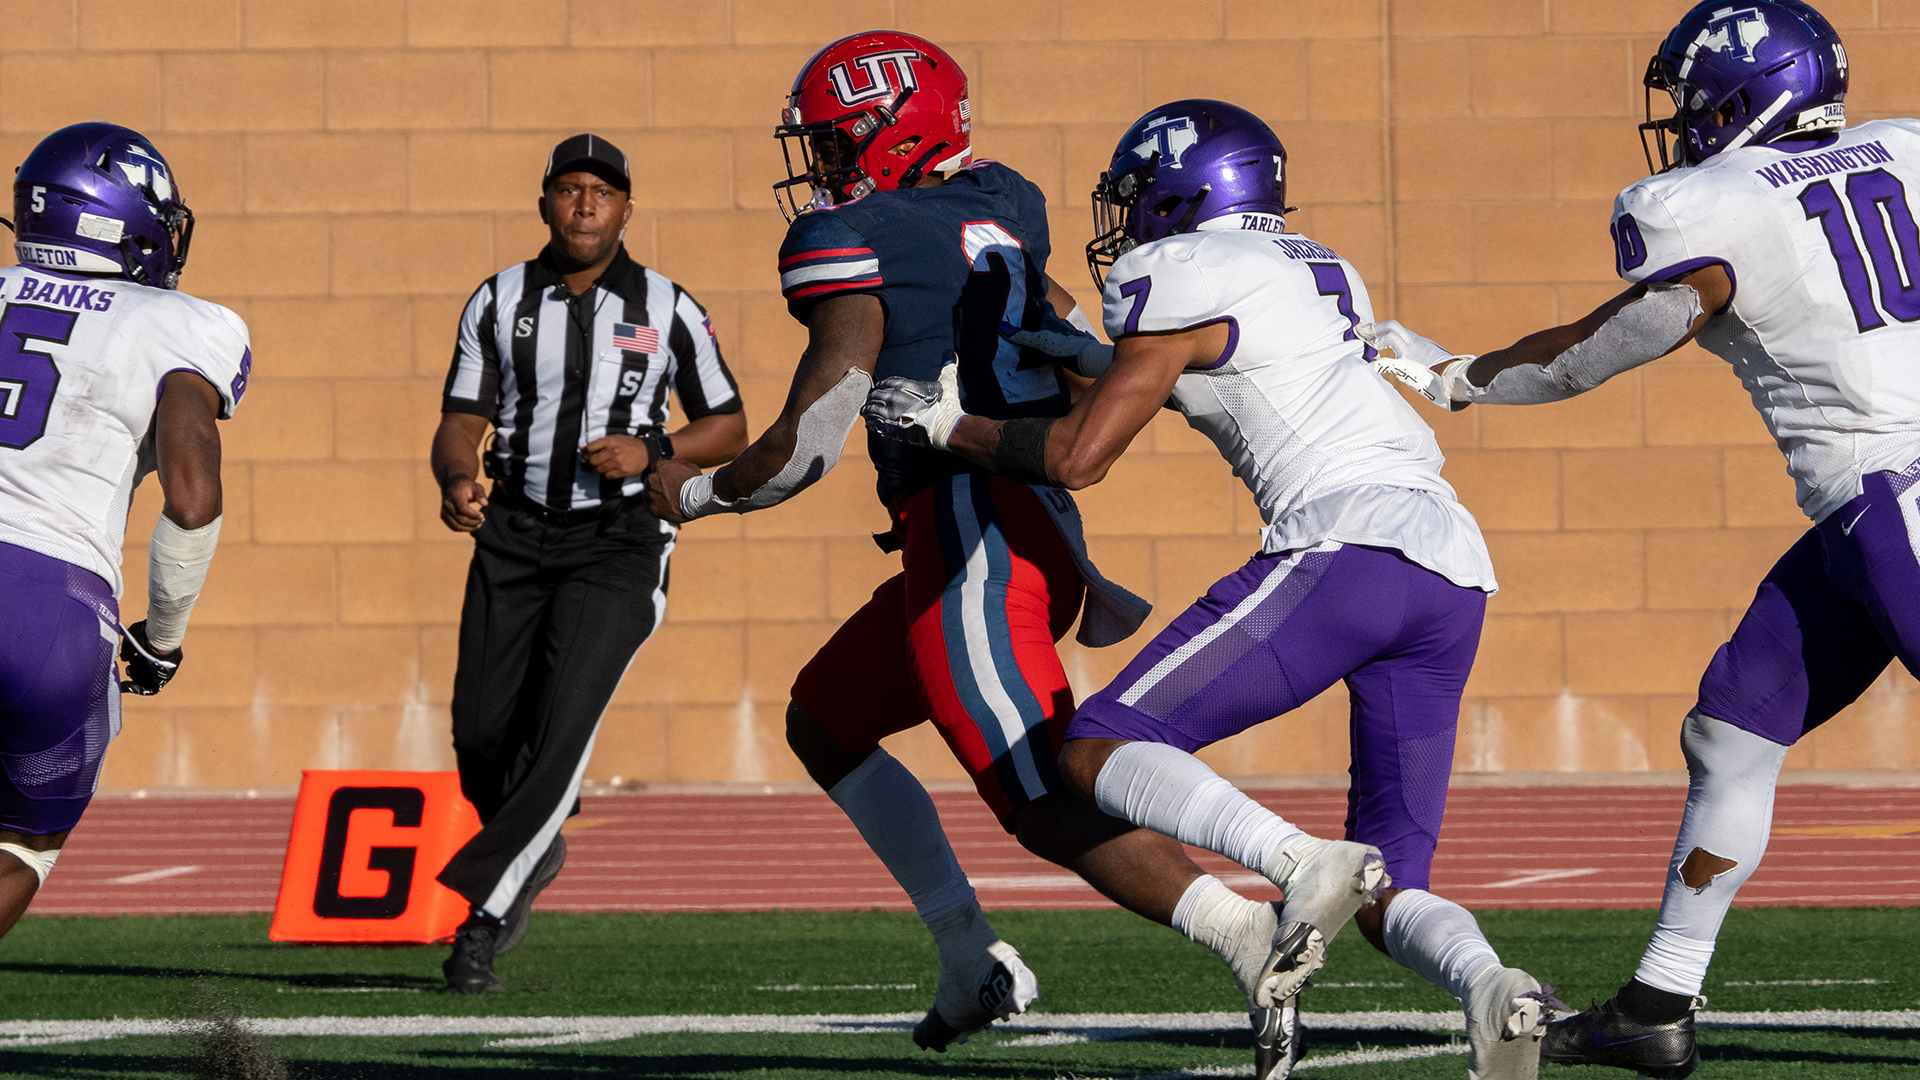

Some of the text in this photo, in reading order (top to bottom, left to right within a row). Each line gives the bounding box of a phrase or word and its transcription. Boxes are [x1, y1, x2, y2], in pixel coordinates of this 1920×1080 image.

[1832, 43, 1848, 69] 10
[1273, 155, 1282, 182] 7
[1755, 140, 1895, 189] WASHINGTON
[31, 185, 46, 213] 5
[15, 244, 77, 267] ARLETON
[1796, 167, 1920, 334] 10
[15, 276, 116, 312] BANKS
[961, 220, 1061, 404] 2
[1119, 275, 1152, 333] 7
[1305, 261, 1379, 363] 7
[515, 317, 534, 337] S
[0, 302, 79, 451] 5
[619, 370, 643, 396] S
[313, 786, 425, 919] G
